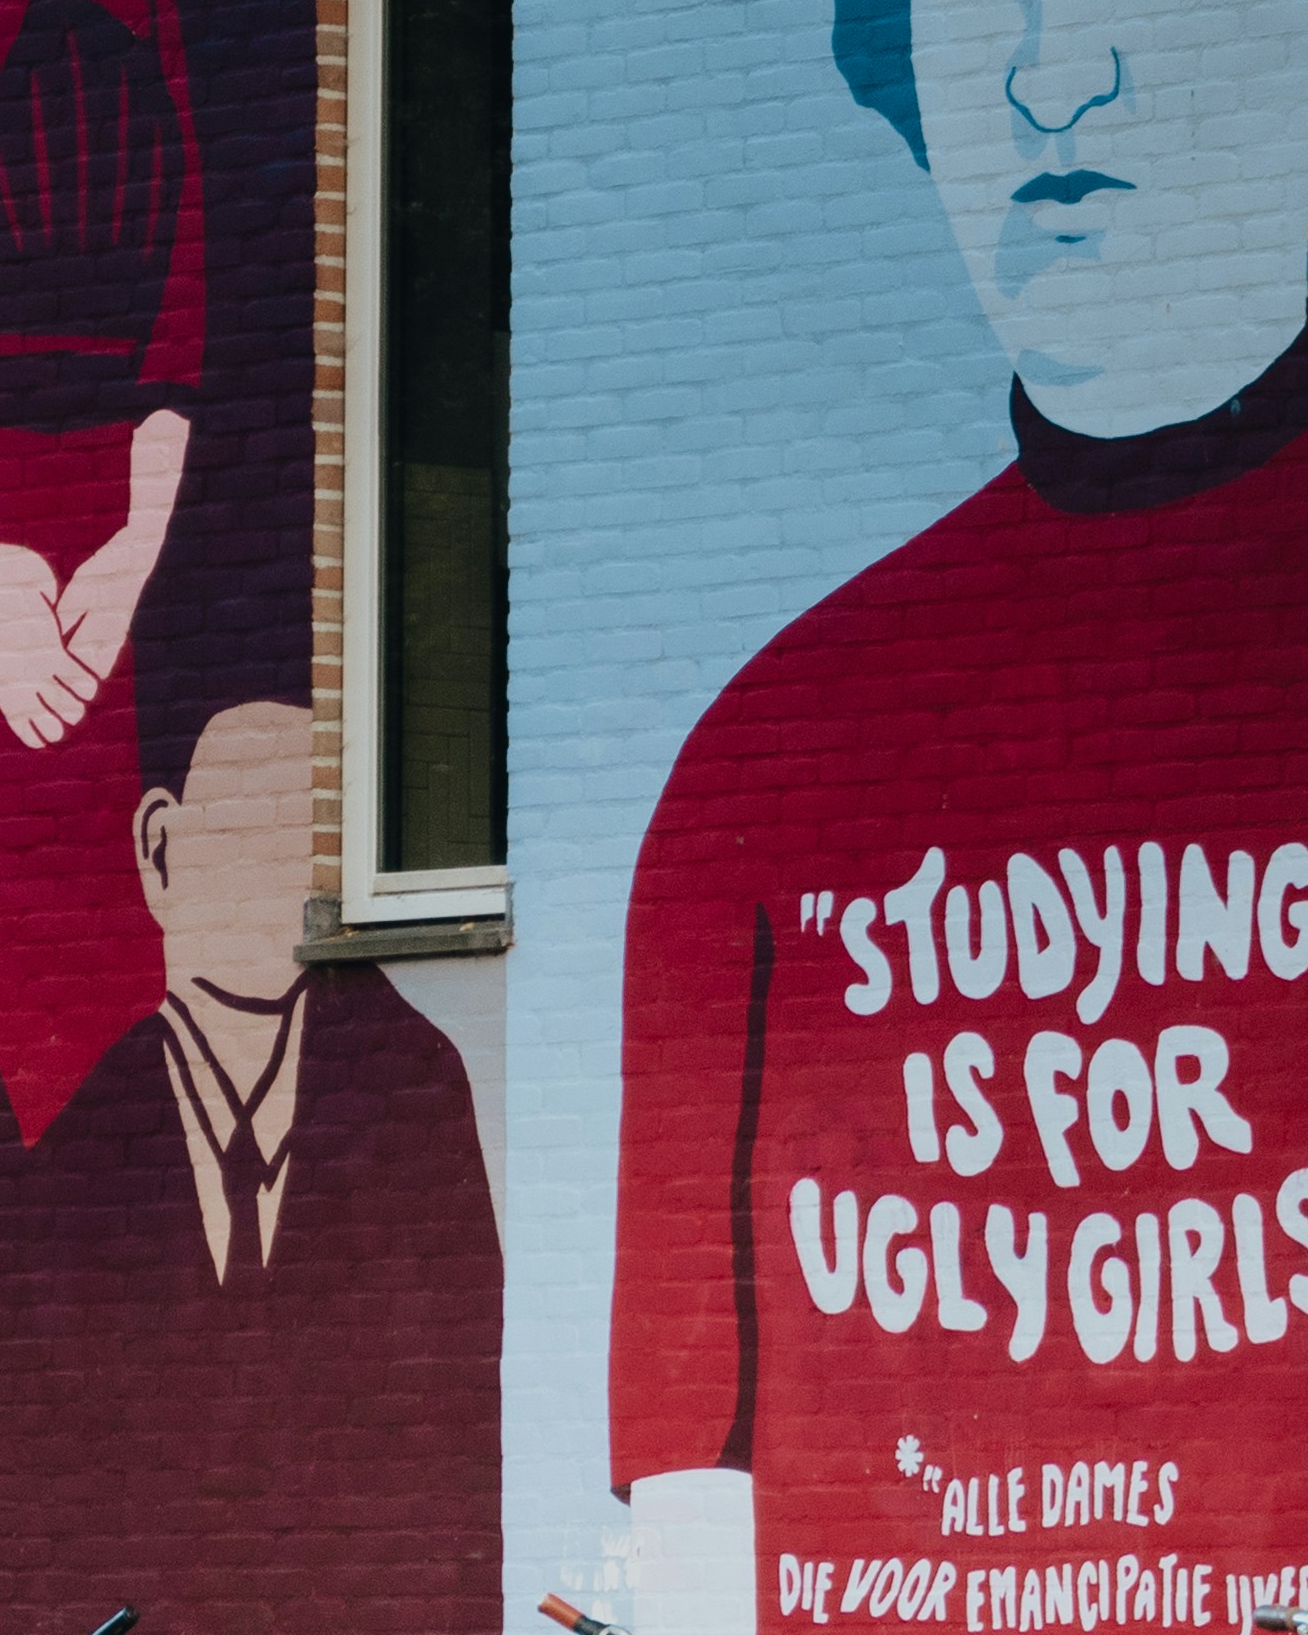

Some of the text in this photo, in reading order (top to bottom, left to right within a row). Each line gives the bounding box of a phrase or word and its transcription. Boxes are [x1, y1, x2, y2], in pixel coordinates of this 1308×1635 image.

[903, 1025, 1253, 1188] IS FOR
[789, 1178, 1048, 1362] UGLY
[1042, 1461, 1179, 1528] DAMES
[779, 1553, 835, 1624] DIE
[840, 1557, 957, 1621] VOOR
[966, 1553, 1212, 1633] EMANCIPATIE
